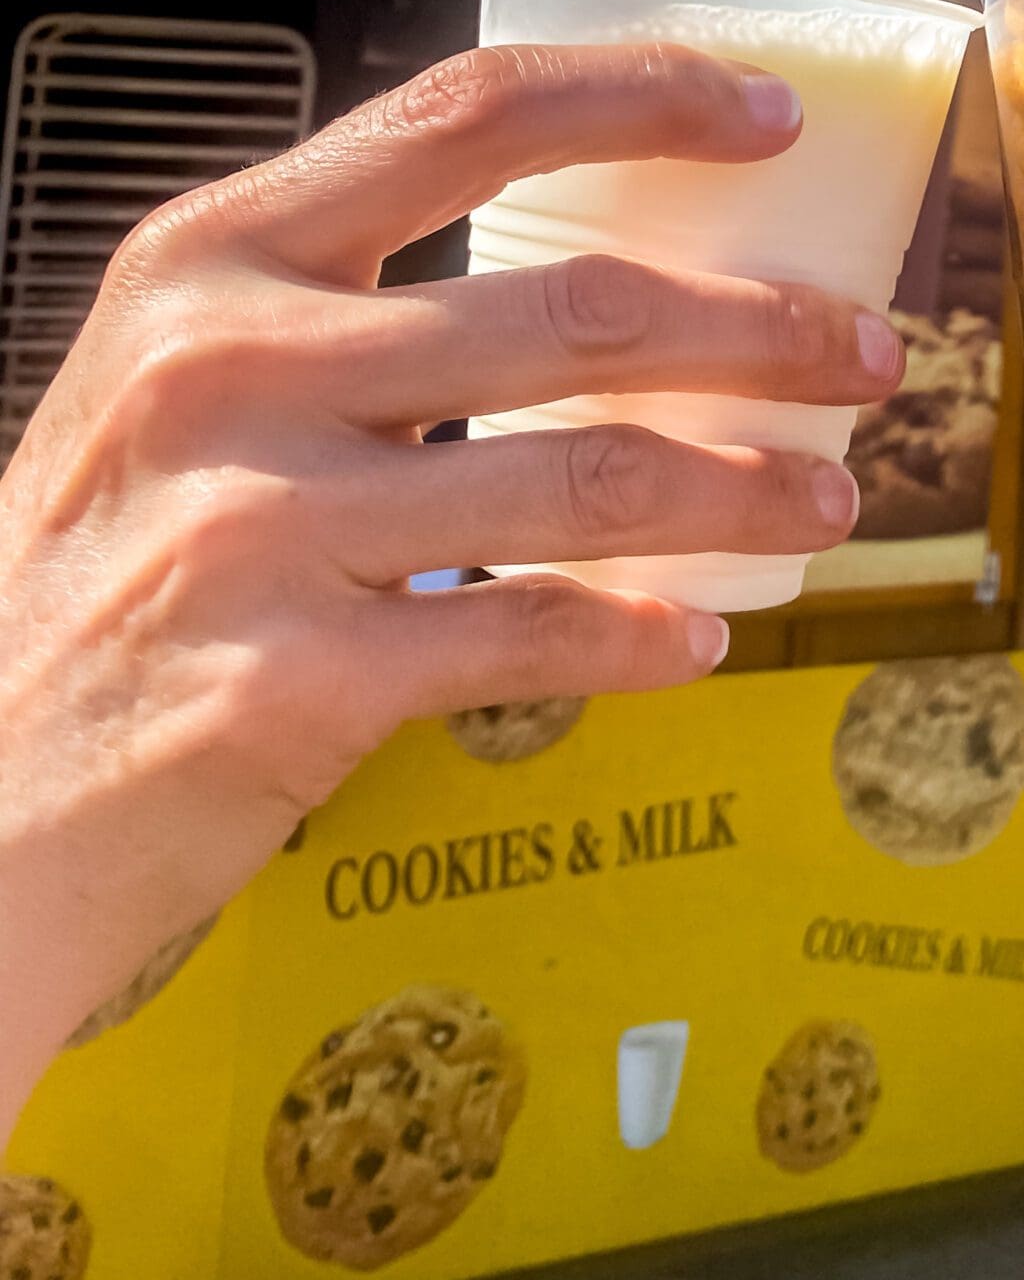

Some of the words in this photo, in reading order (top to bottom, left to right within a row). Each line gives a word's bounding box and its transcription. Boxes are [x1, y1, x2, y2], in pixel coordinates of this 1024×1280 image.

[324, 822, 554, 920] COOKIES
[567, 820, 602, 875] &
[615, 792, 737, 867] MILK
[803, 916, 942, 973] COOKIES
